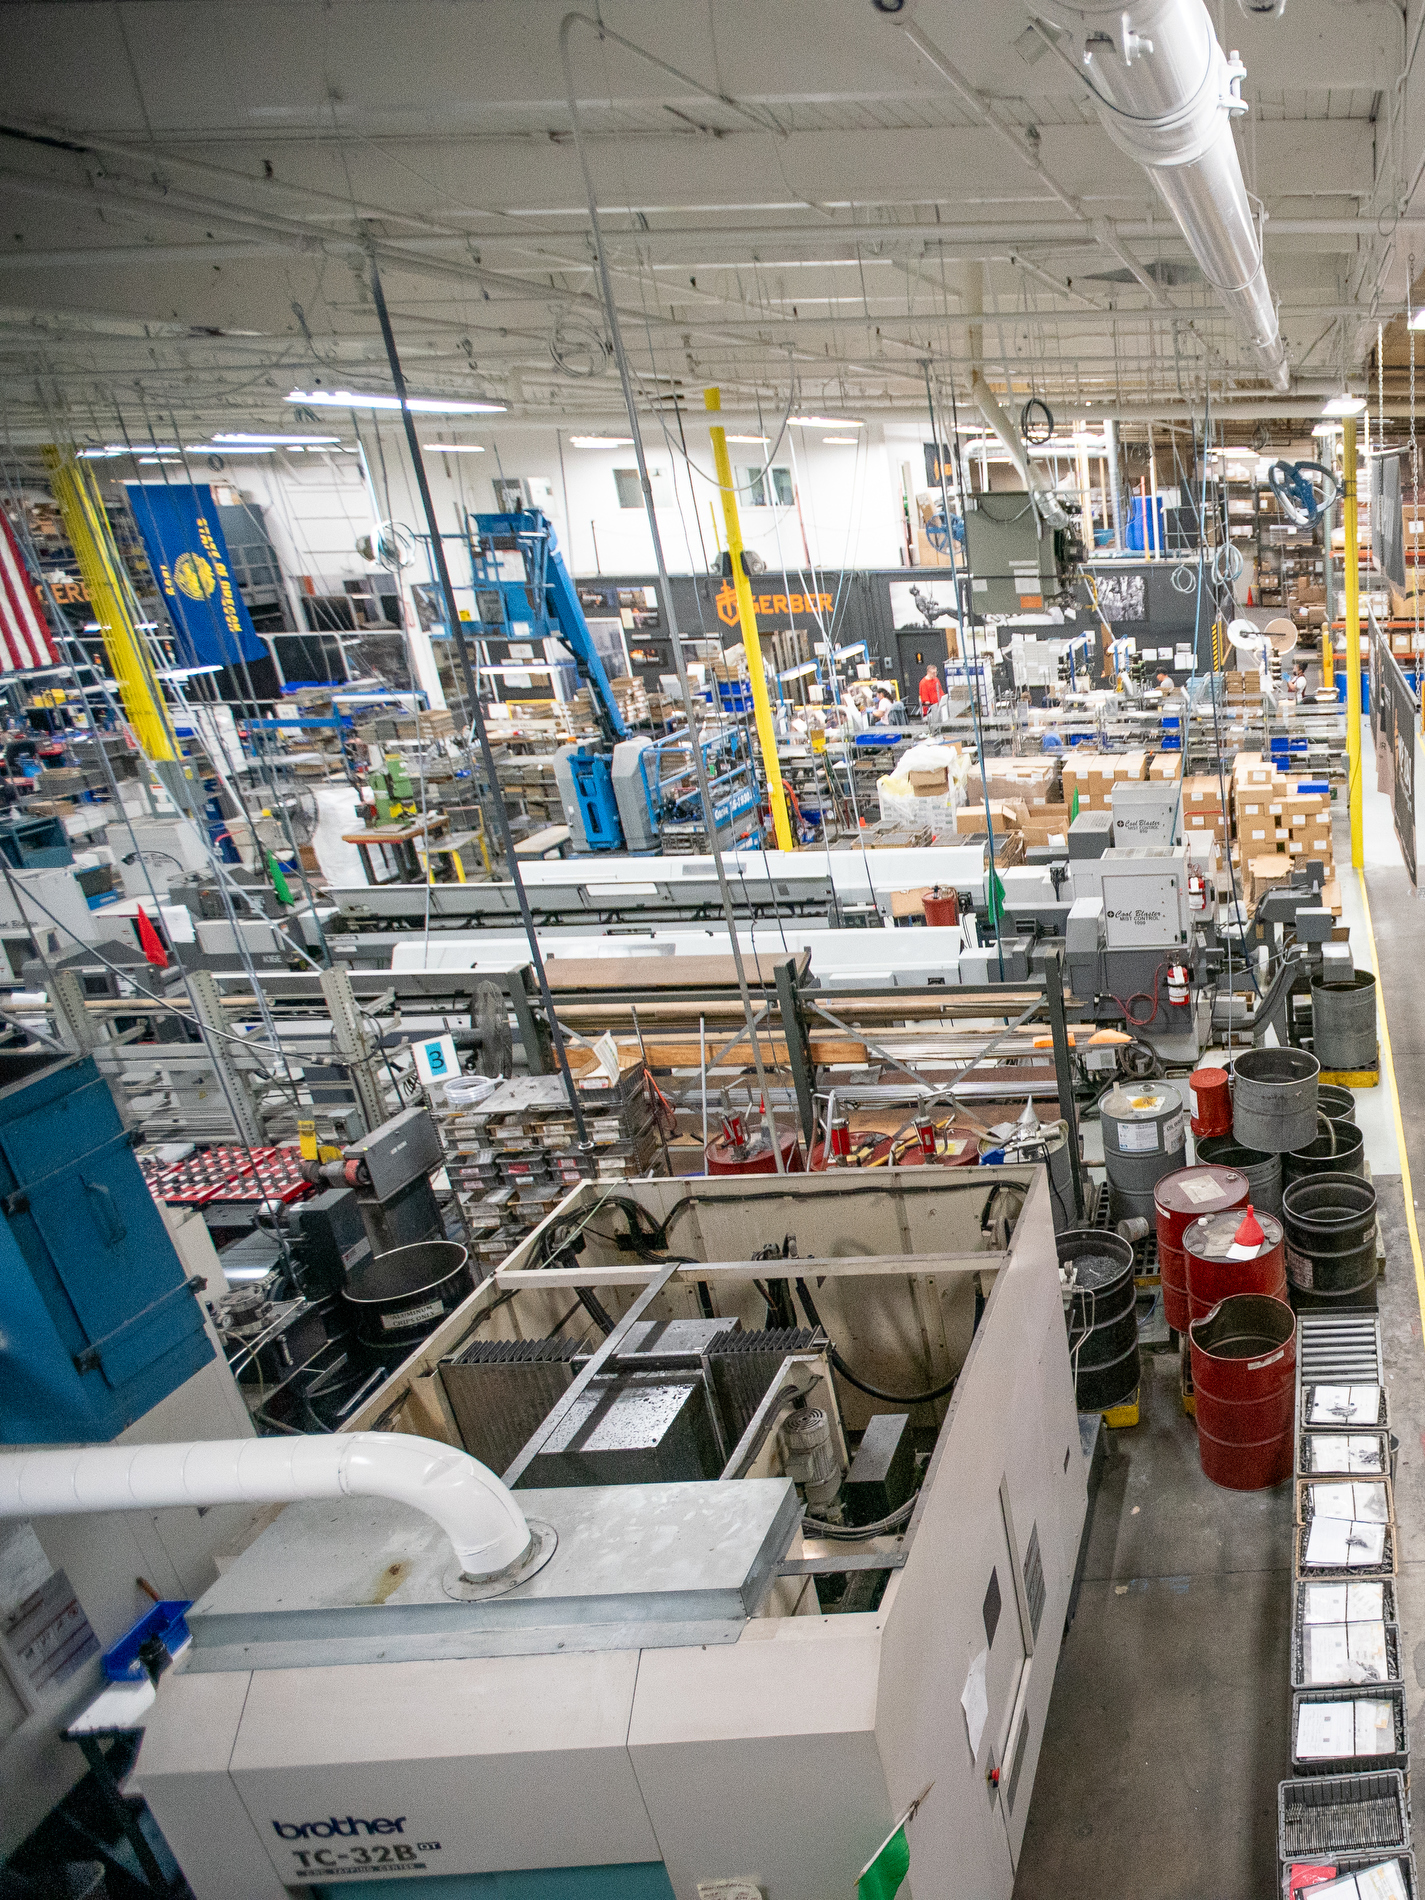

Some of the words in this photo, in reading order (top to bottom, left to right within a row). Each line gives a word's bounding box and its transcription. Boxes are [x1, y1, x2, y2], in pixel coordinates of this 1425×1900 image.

[752, 593, 833, 614] GERBER
[1115, 909, 1132, 918] Cool
[1135, 909, 1161, 917] Blaster
[429, 1050, 445, 1069] 3
[392, 1305, 433, 1320] ALUMINUM
[393, 1318, 415, 1326] CHIPS
[416, 1311, 435, 1321] ONLY
[272, 1816, 406, 1840] brother
[292, 1843, 417, 1867] TC-32B
